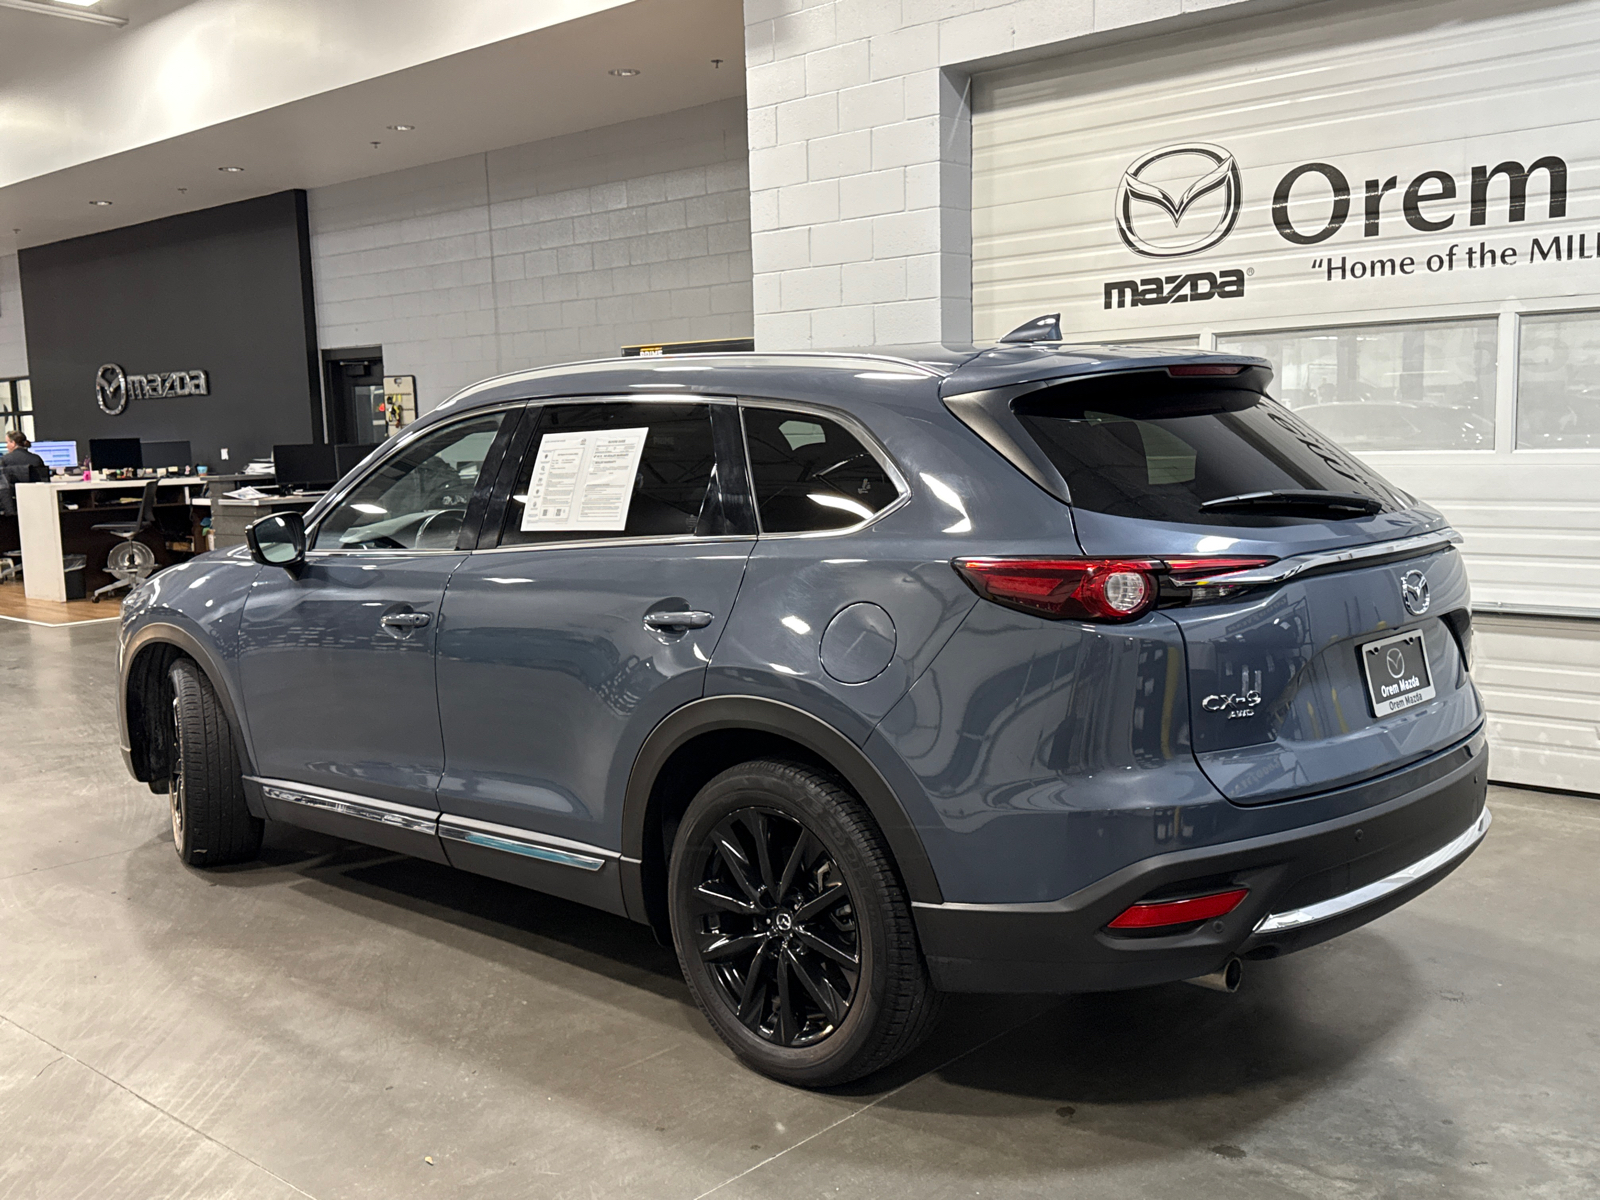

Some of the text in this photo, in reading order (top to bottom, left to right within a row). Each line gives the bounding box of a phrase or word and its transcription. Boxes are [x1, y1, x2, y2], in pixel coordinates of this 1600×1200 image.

[1272, 156, 1567, 245] Orem
[1426, 244, 1459, 273] of
[1465, 242, 1517, 269] the
[1381, 675, 1420, 698] Orem Mazda
[1202, 690, 1262, 711] CX-9
[1389, 693, 1423, 711] Orem Mazda
[1228, 709, 1255, 719] AWD
